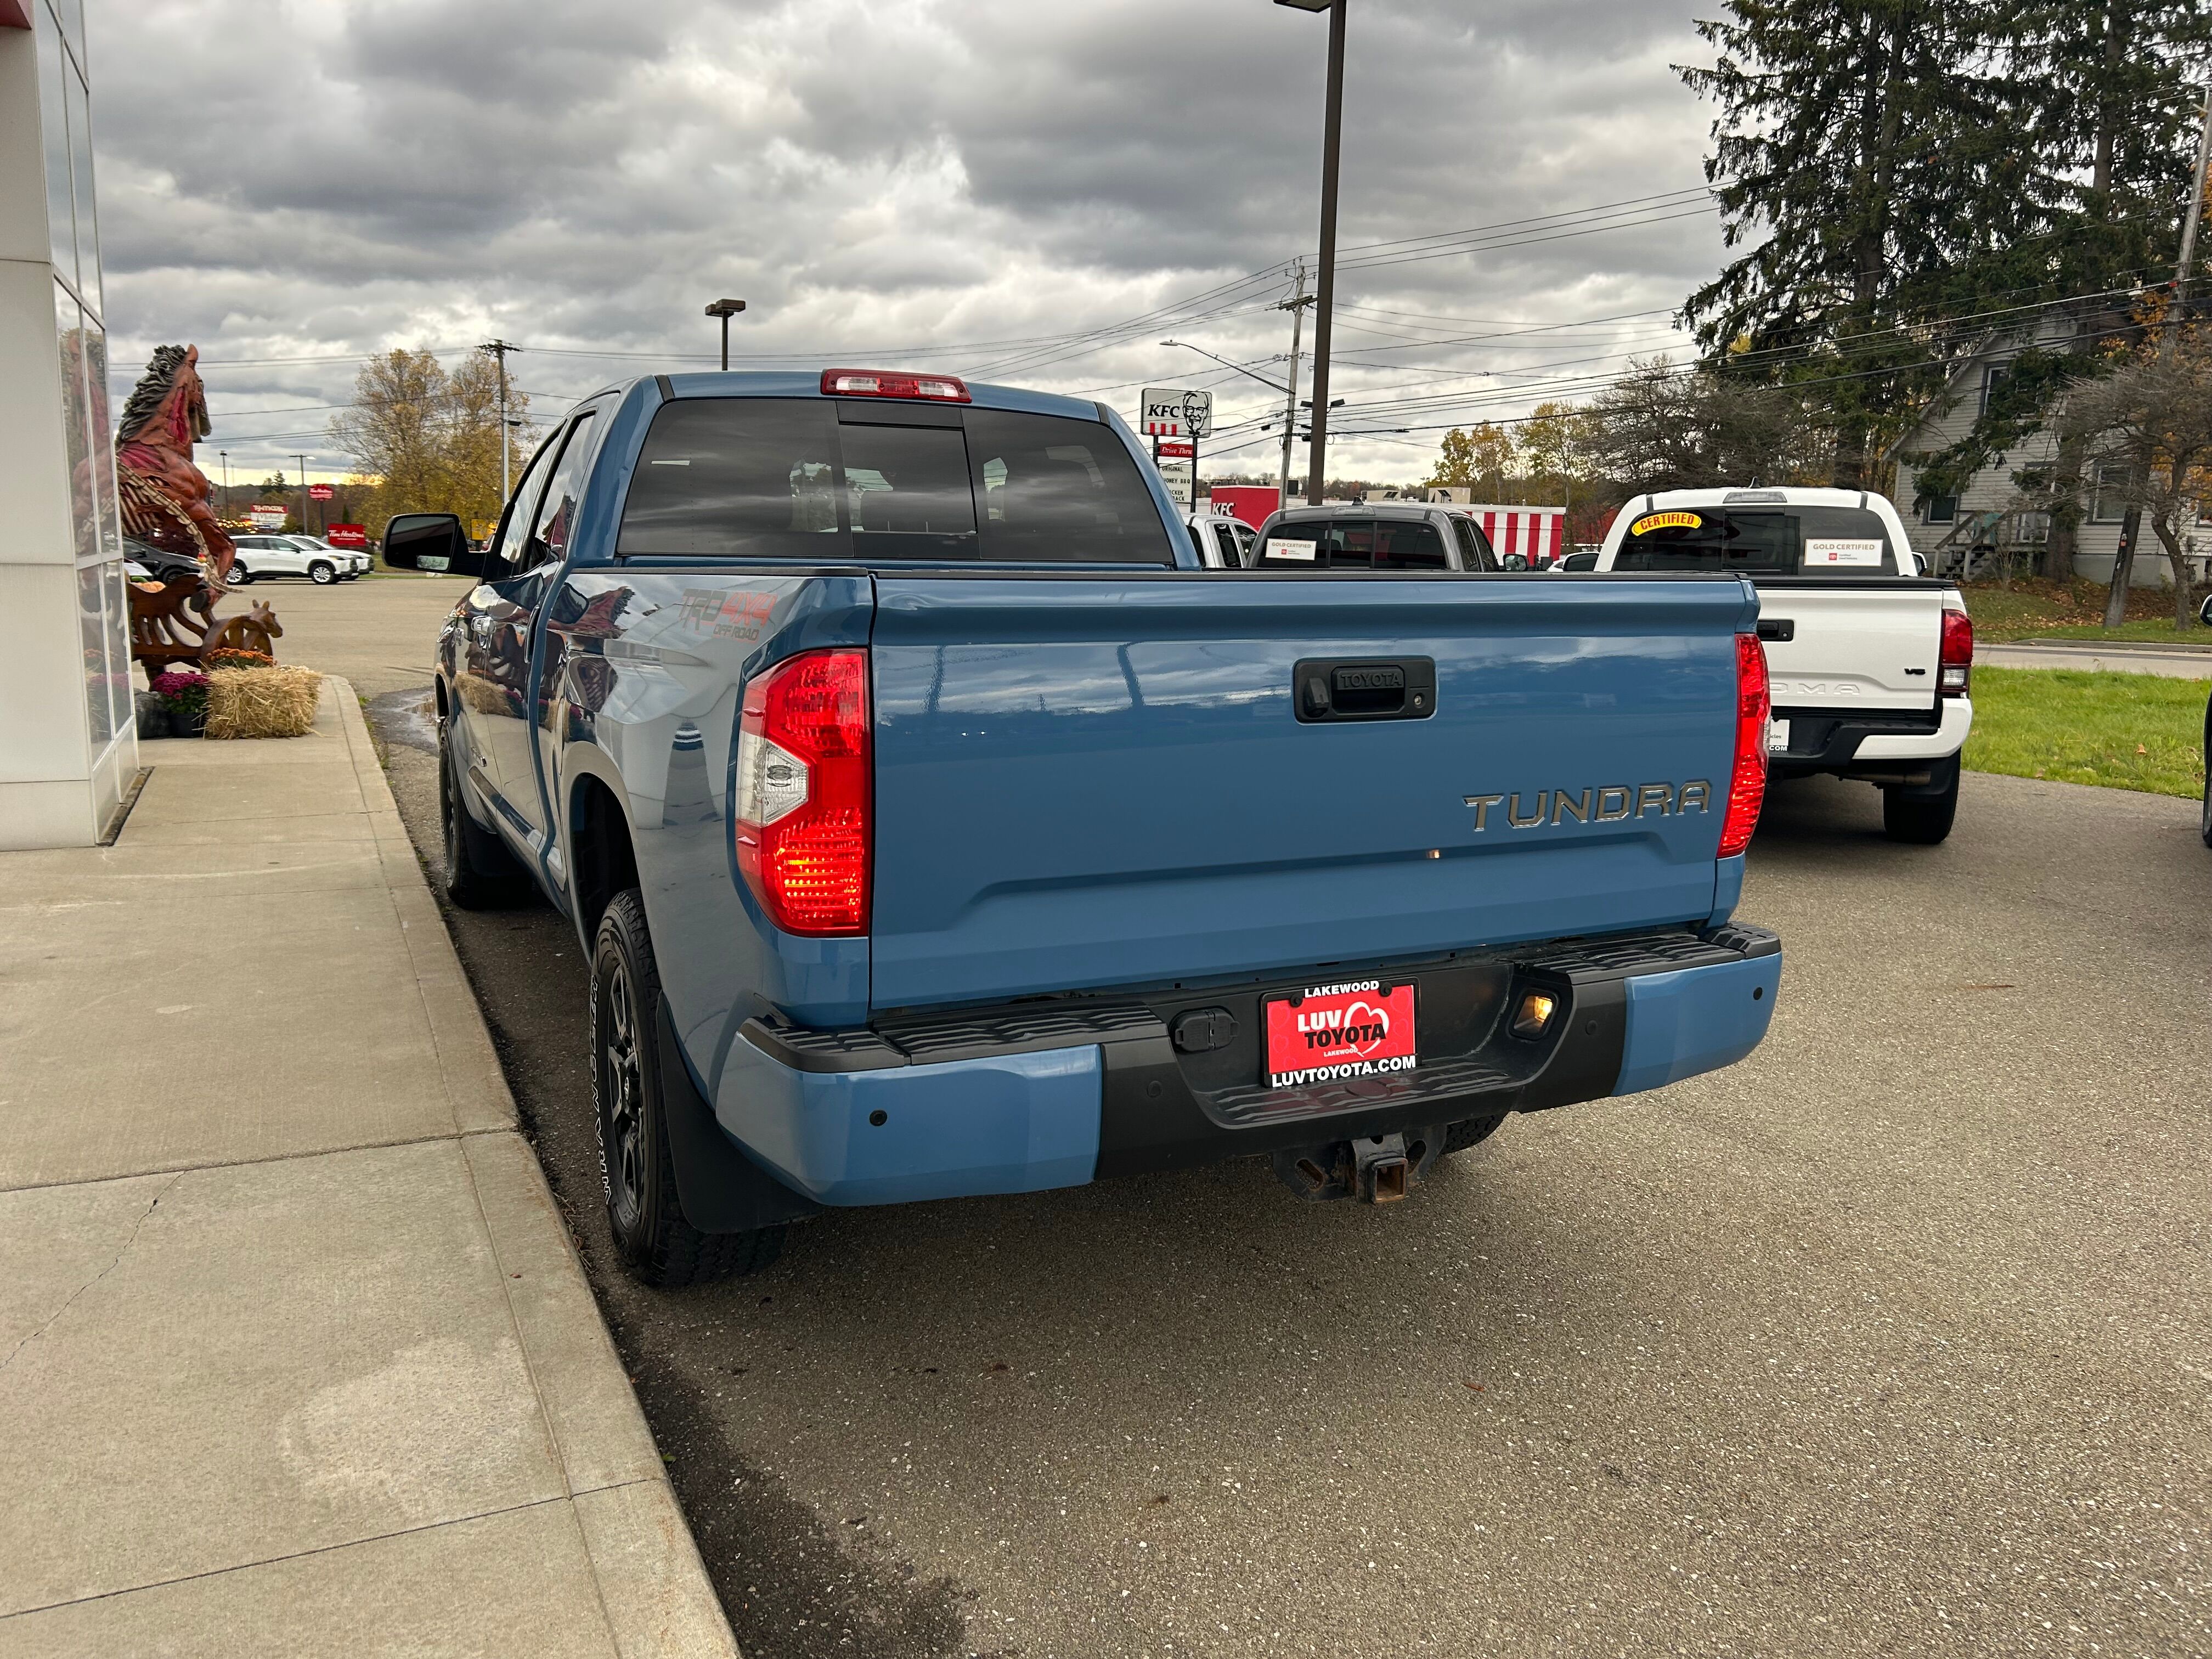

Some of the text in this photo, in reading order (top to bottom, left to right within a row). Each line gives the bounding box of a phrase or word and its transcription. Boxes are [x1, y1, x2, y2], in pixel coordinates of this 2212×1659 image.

[1148, 404, 1180, 417] KFC
[1212, 503, 1234, 516] KFC
[1640, 514, 1695, 530] CERTIFIED
[679, 588, 727, 635] TRD
[713, 623, 760, 644] OFF ROAD
[1340, 673, 1402, 688] TOYOTA
[1462, 778, 1712, 832] TUNDRA
[1304, 980, 1380, 998] LAKEWOOD
[1297, 1009, 1342, 1032] LUV
[1304, 1023, 1387, 1049] TOYOTA
[1323, 1047, 1359, 1058] LAKEWOOD
[1271, 1055, 1417, 1088] LUVTOYOTA.COM
[589, 975, 612, 1205] WRANGLER
